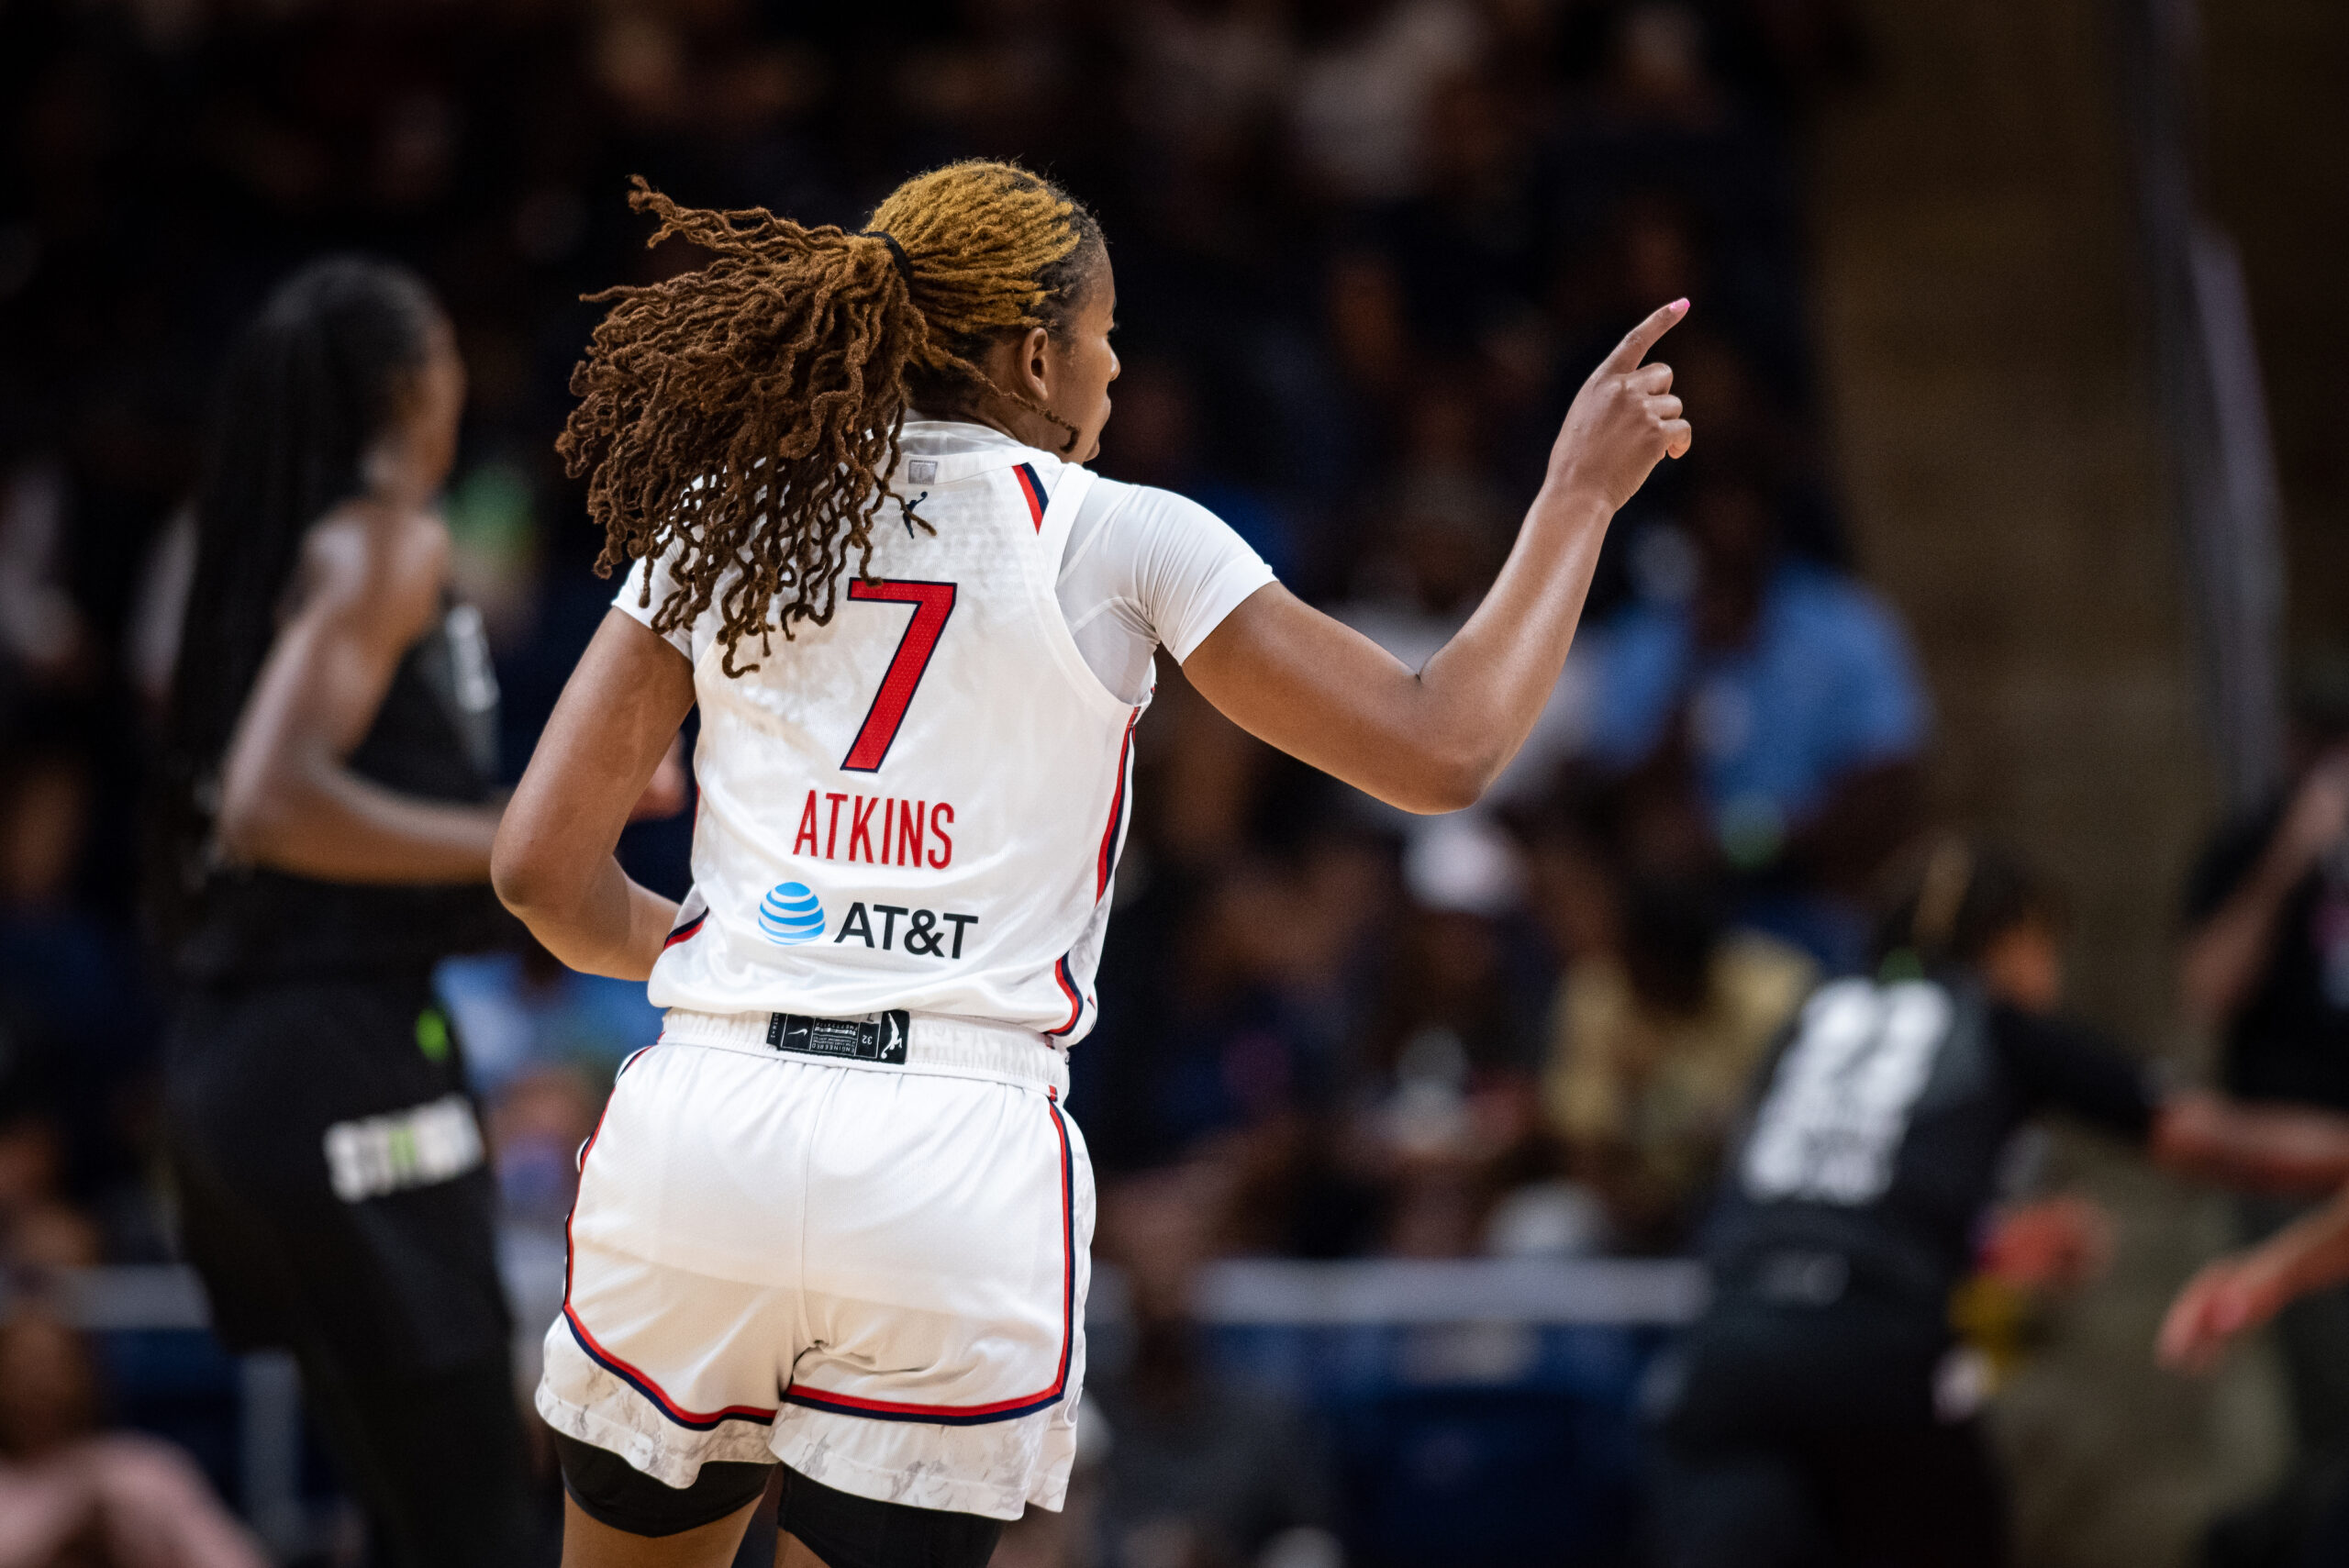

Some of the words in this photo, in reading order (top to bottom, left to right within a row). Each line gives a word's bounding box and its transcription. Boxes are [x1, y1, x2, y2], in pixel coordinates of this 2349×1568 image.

[840, 577, 958, 773] 7
[792, 789, 955, 870] ATKINS
[833, 901, 979, 960] AT&T
[862, 1034, 873, 1045] 32
